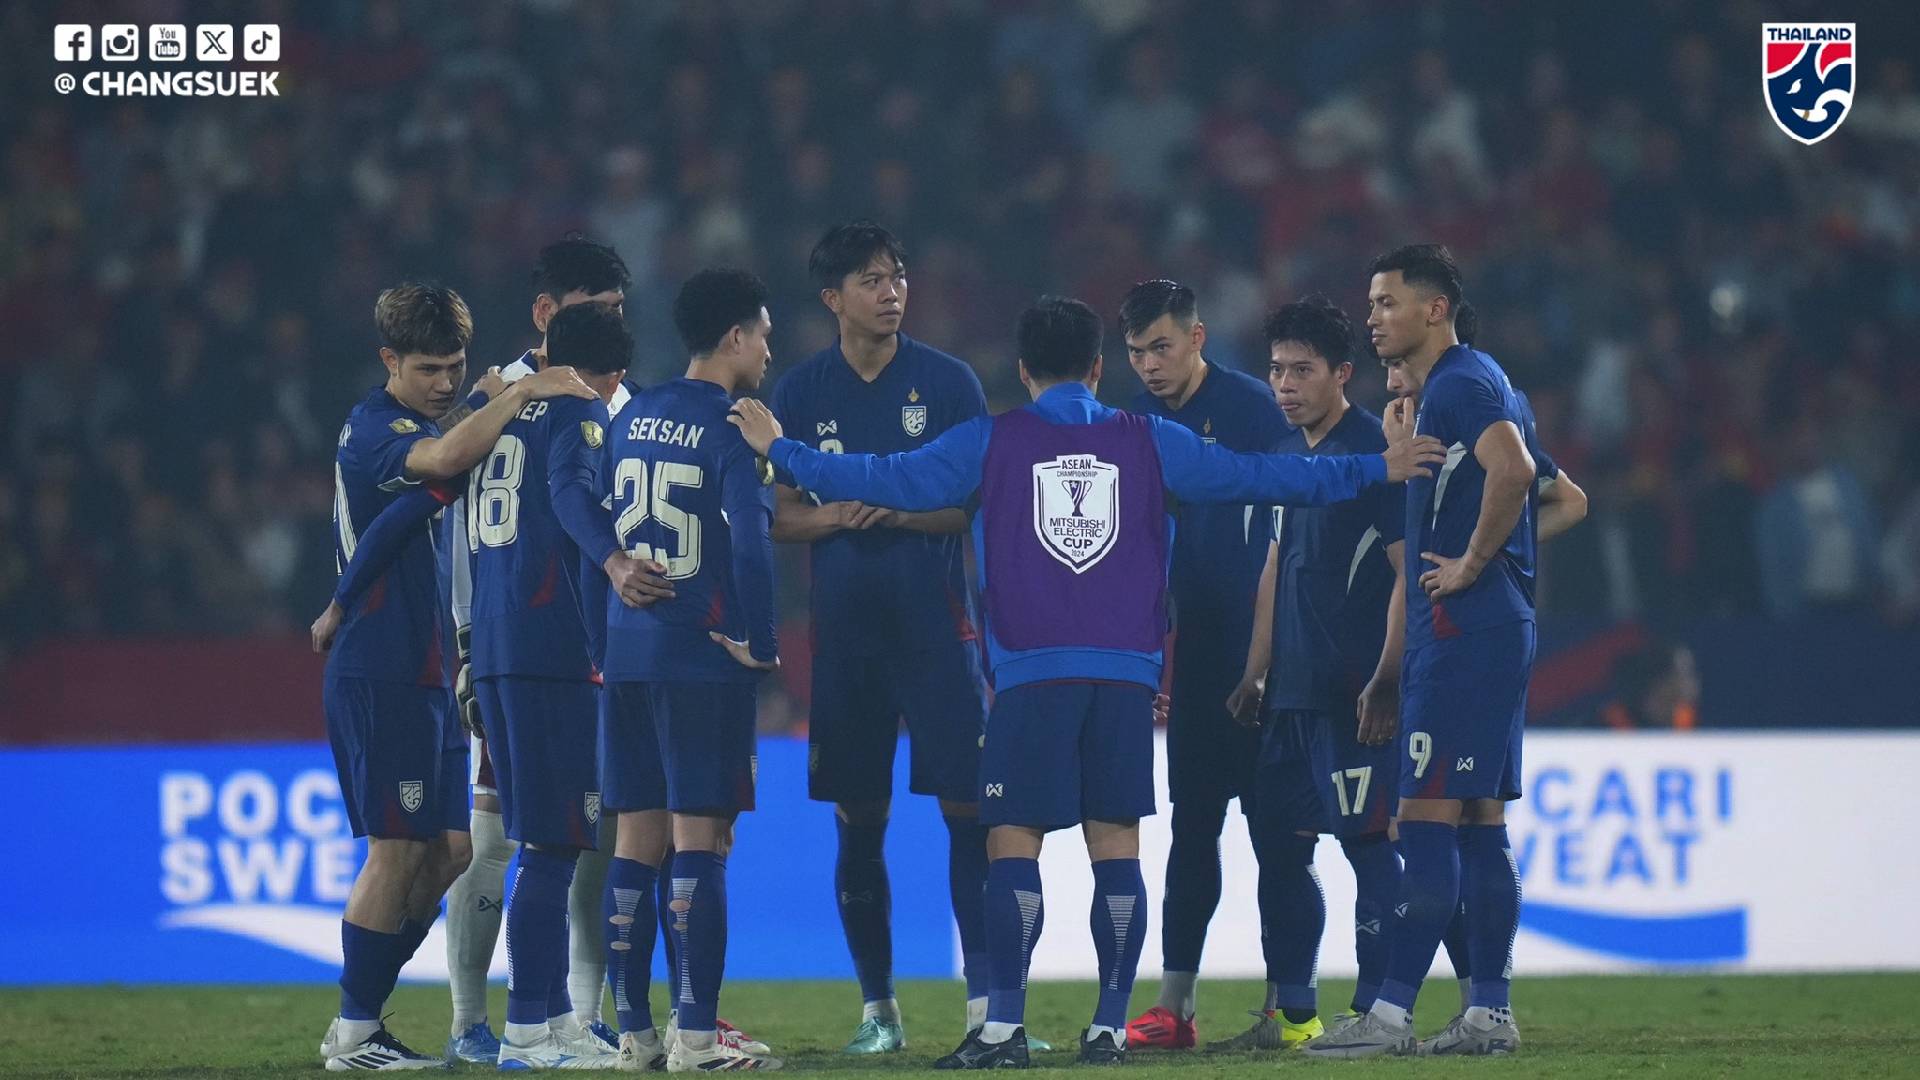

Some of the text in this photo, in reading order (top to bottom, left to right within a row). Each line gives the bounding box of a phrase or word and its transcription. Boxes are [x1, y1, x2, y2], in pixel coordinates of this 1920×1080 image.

[515, 401, 549, 421] EP
[628, 417, 704, 449] SEKSAN
[1056, 470, 1098, 478] CHAMPIONSHIP
[1061, 459, 1092, 470] ASEAN
[614, 457, 703, 580] 25
[1049, 517, 1106, 529] MITSUBISHI
[1053, 527, 1103, 538] ELECTRIC
[1062, 537, 1094, 550] CUP
[1409, 731, 1433, 779] 9
[159, 768, 347, 840] POC
[1330, 765, 1373, 817] 17
[1532, 767, 1734, 822] CARI
[160, 836, 358, 903] SWE
